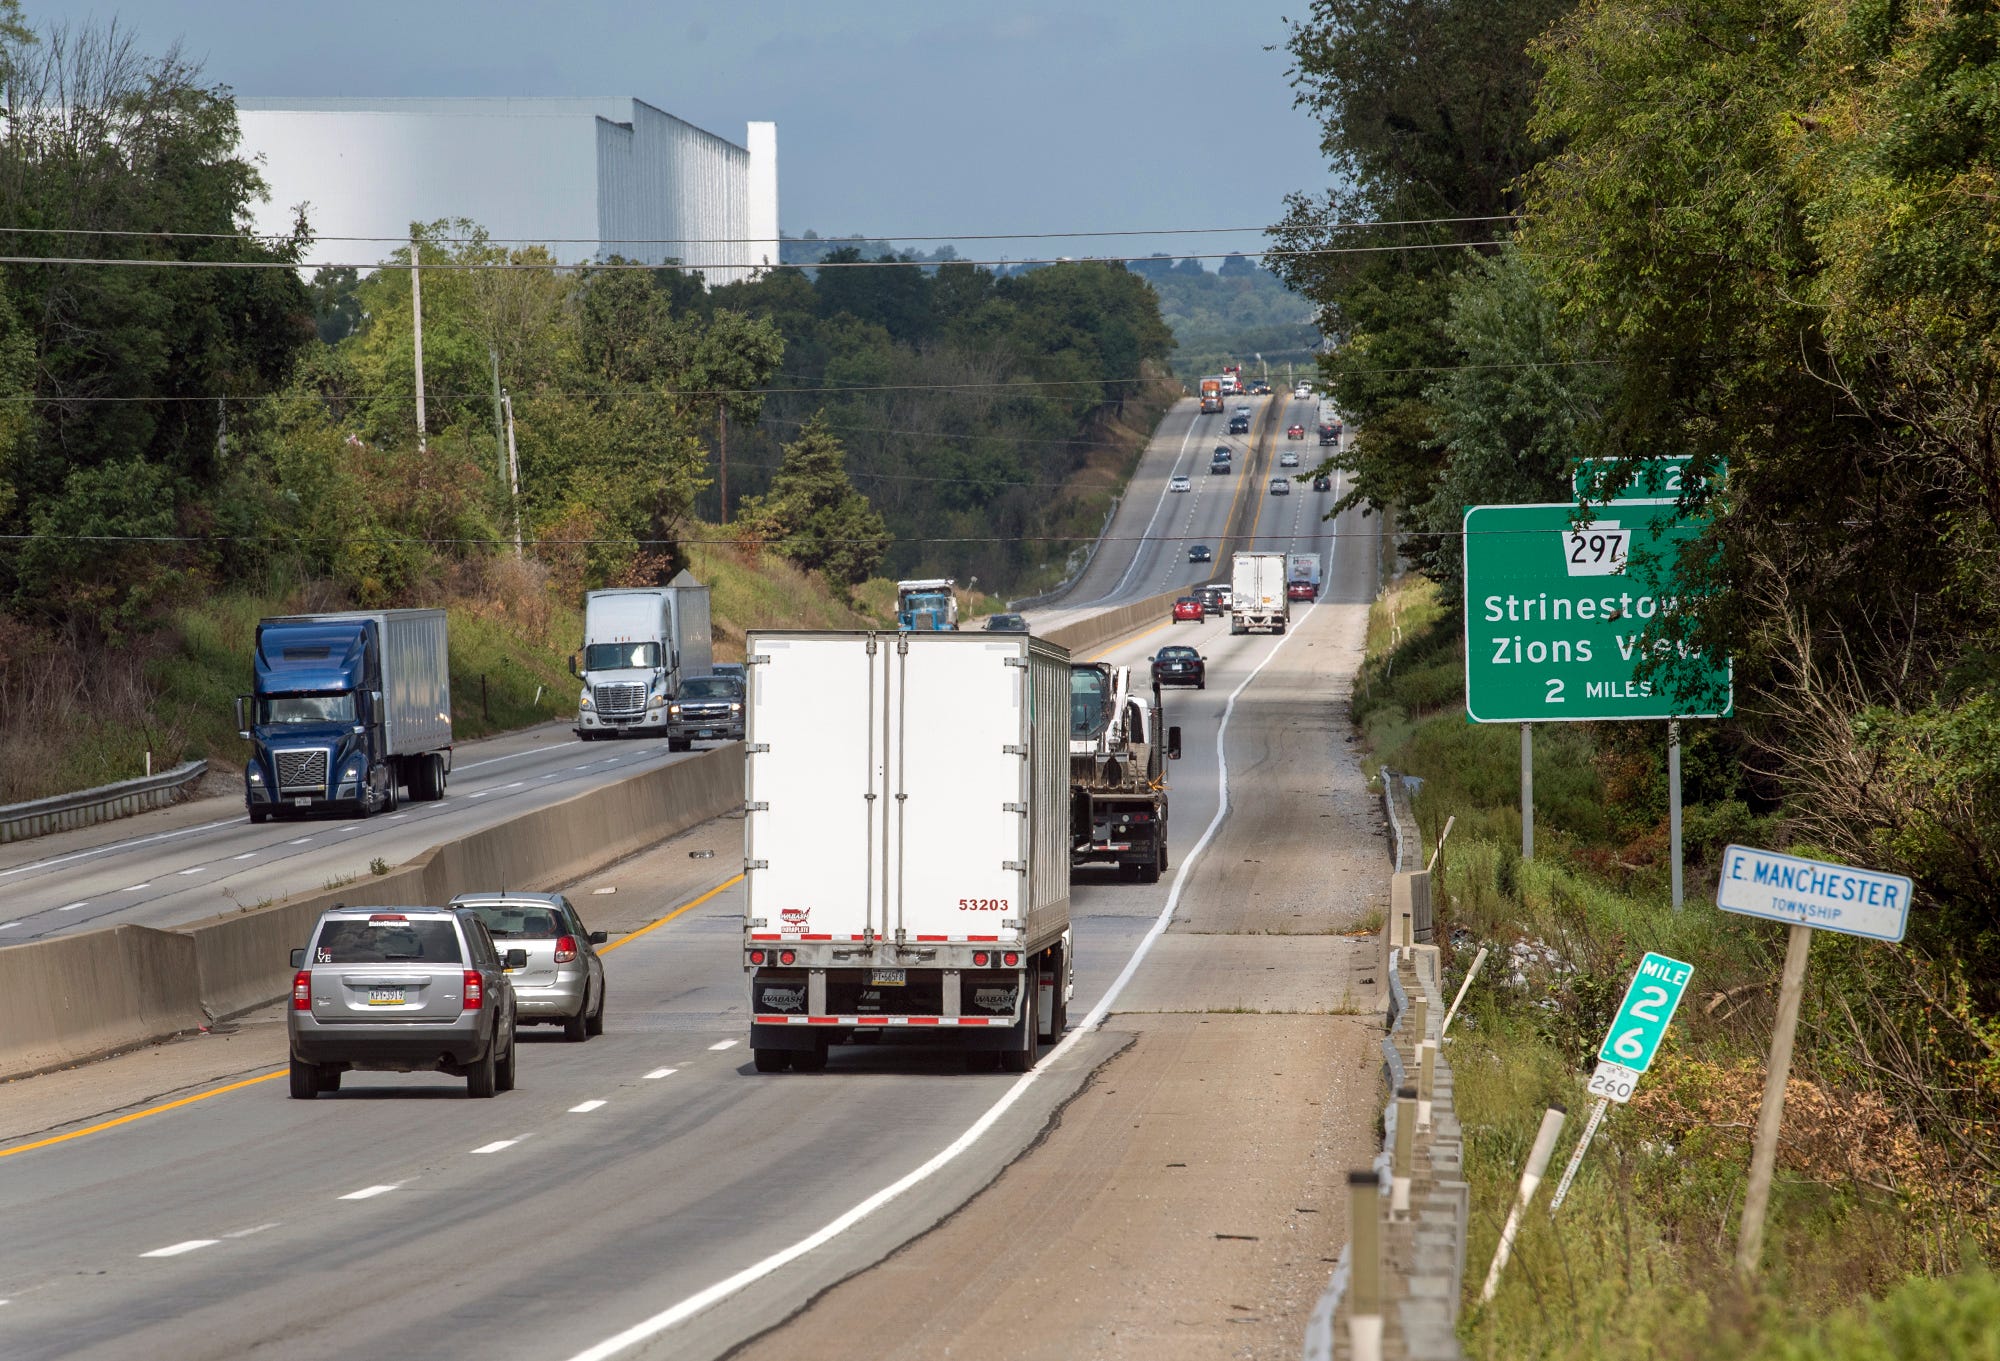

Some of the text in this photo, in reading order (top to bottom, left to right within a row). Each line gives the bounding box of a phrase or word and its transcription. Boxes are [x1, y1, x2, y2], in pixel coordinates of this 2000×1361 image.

[1570, 535, 1623, 563] 297
[1491, 636, 1593, 663] Zions
[1545, 678, 1653, 703] 2 MILES
[1732, 856, 1899, 909] E. MANCHESTER
[958, 899, 1009, 911] 53203
[1771, 897, 1842, 921] TOWNSHIP
[1641, 961, 1689, 986] MILE
[1629, 985, 1669, 1022] 2
[1613, 1027, 1643, 1059] 6
[1591, 1075, 1631, 1098] 260
